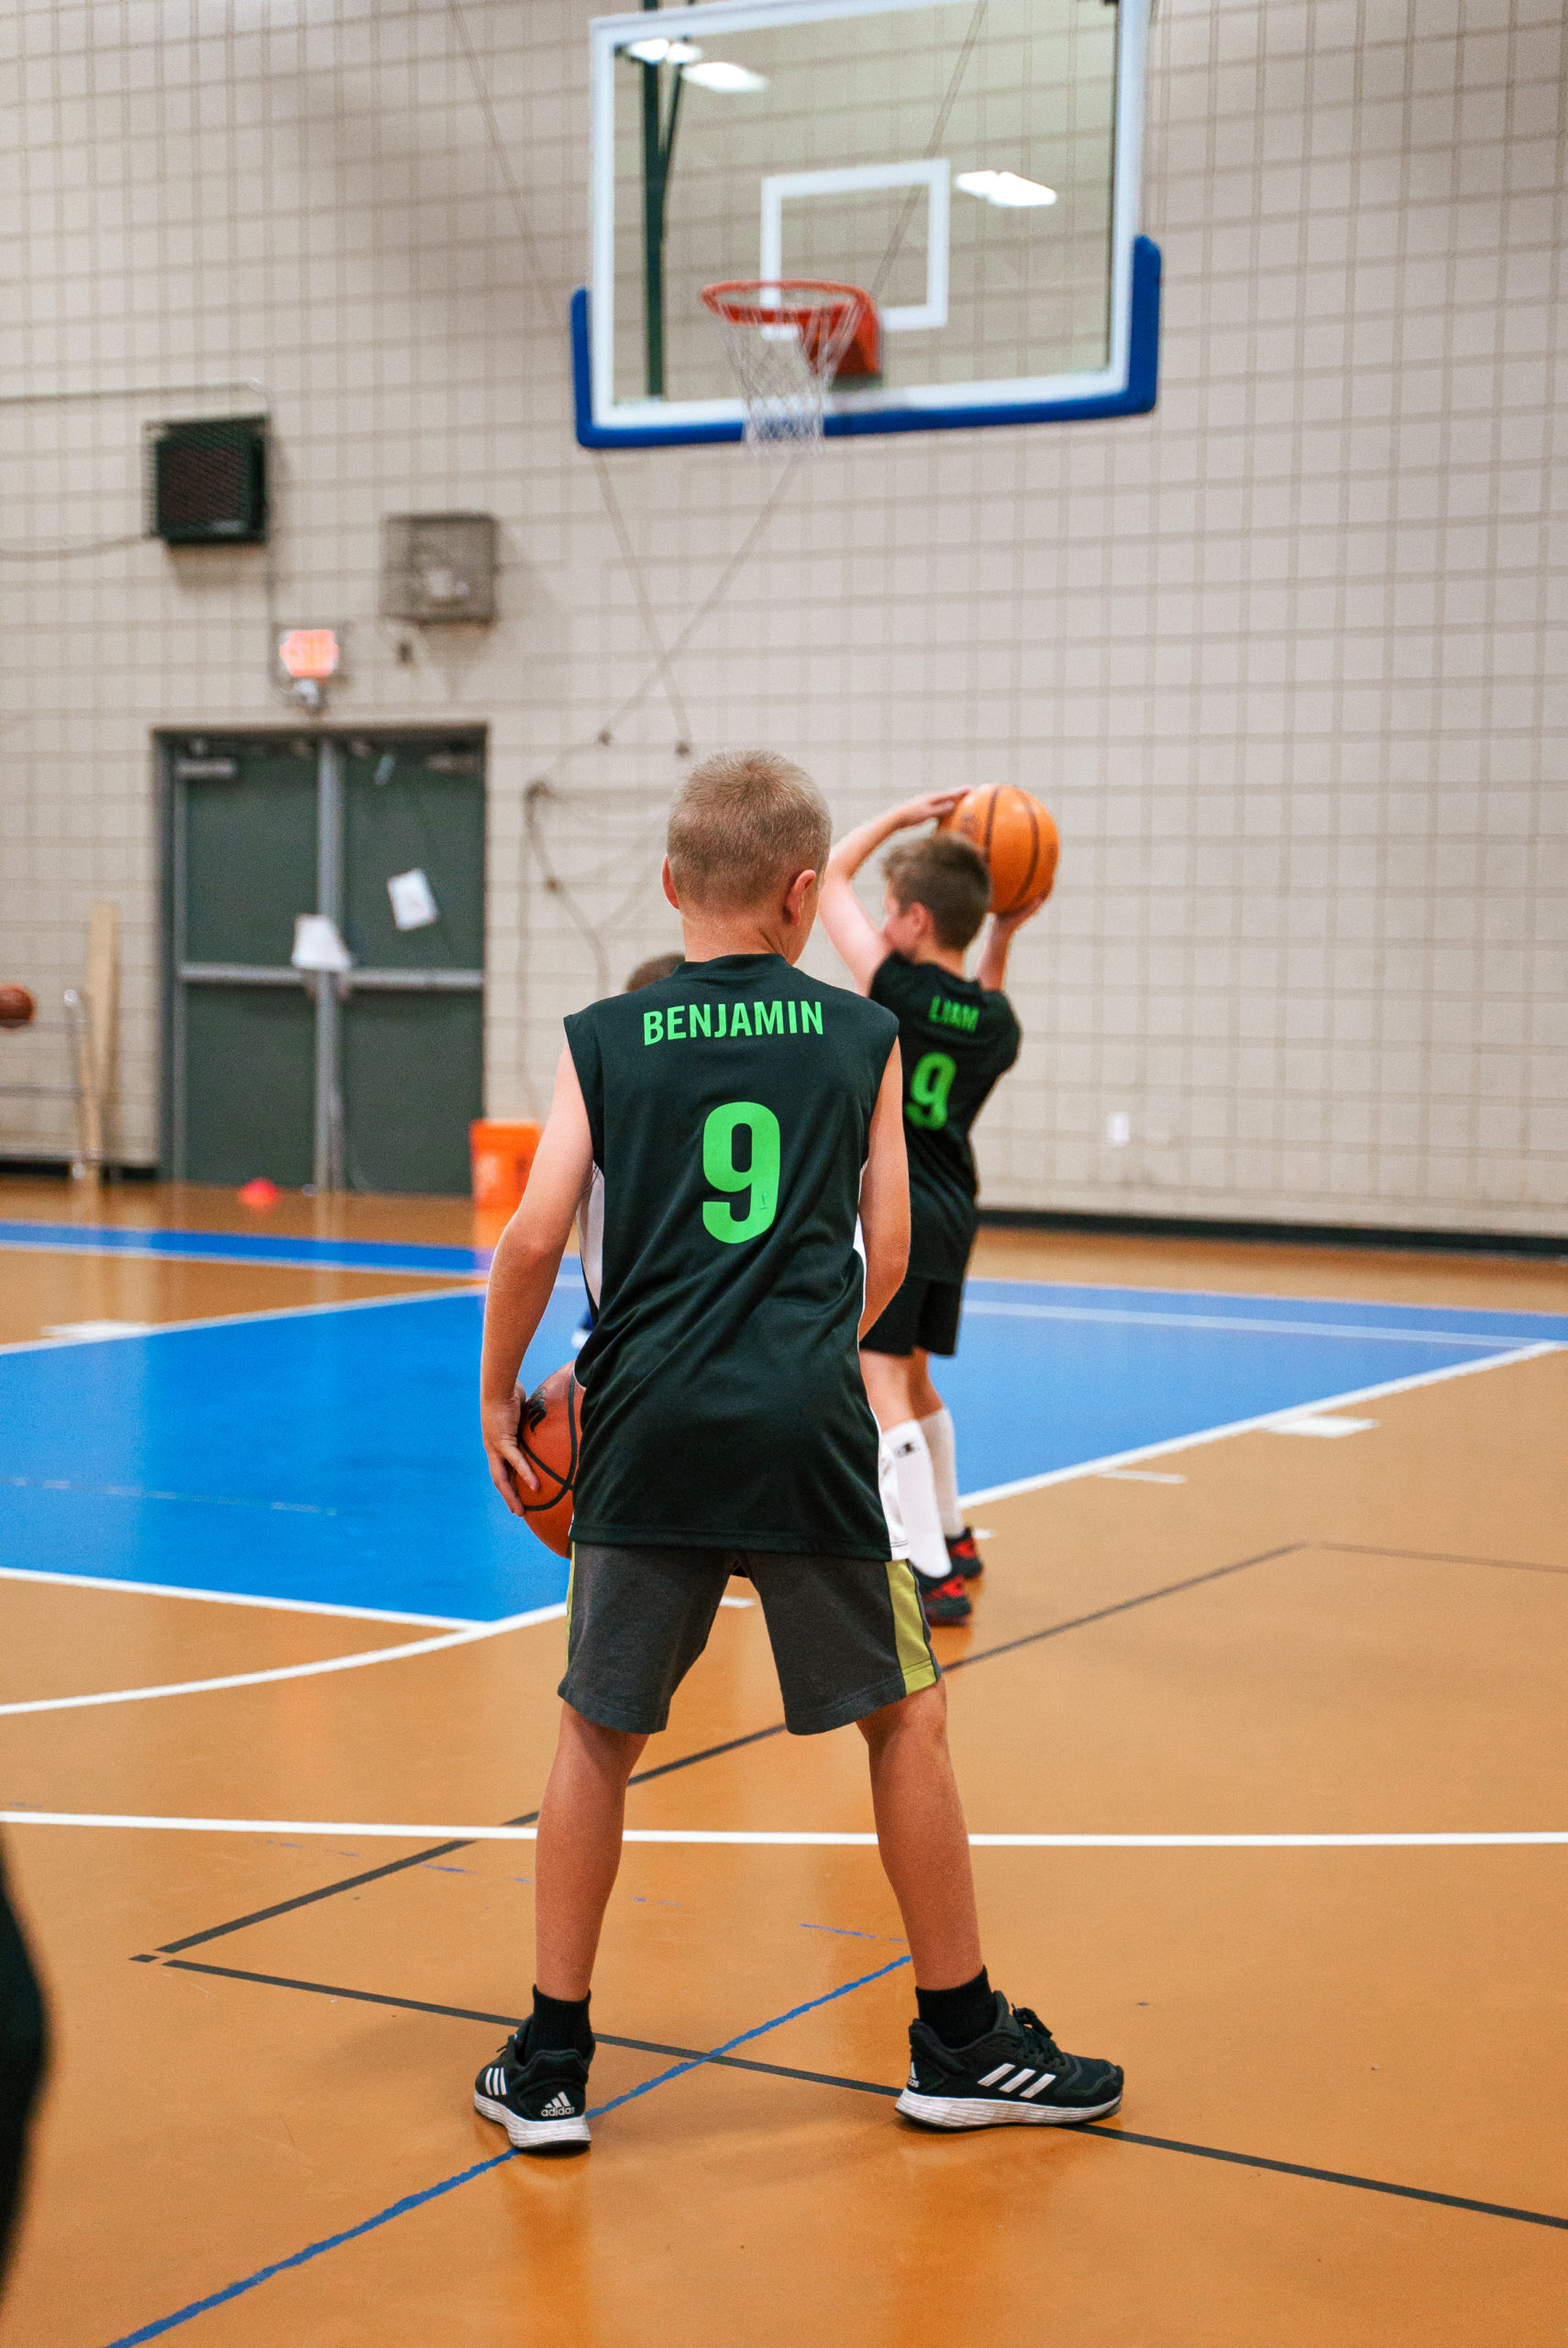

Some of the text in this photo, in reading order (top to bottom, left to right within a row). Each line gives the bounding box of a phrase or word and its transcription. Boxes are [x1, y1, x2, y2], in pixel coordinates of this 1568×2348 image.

[643, 1001, 823, 1046] BENJAMIN
[928, 995, 980, 1033] LIAM
[906, 1051, 956, 1131] 9
[702, 1102, 780, 1244] 9
[542, 2107, 575, 2117] adidas
